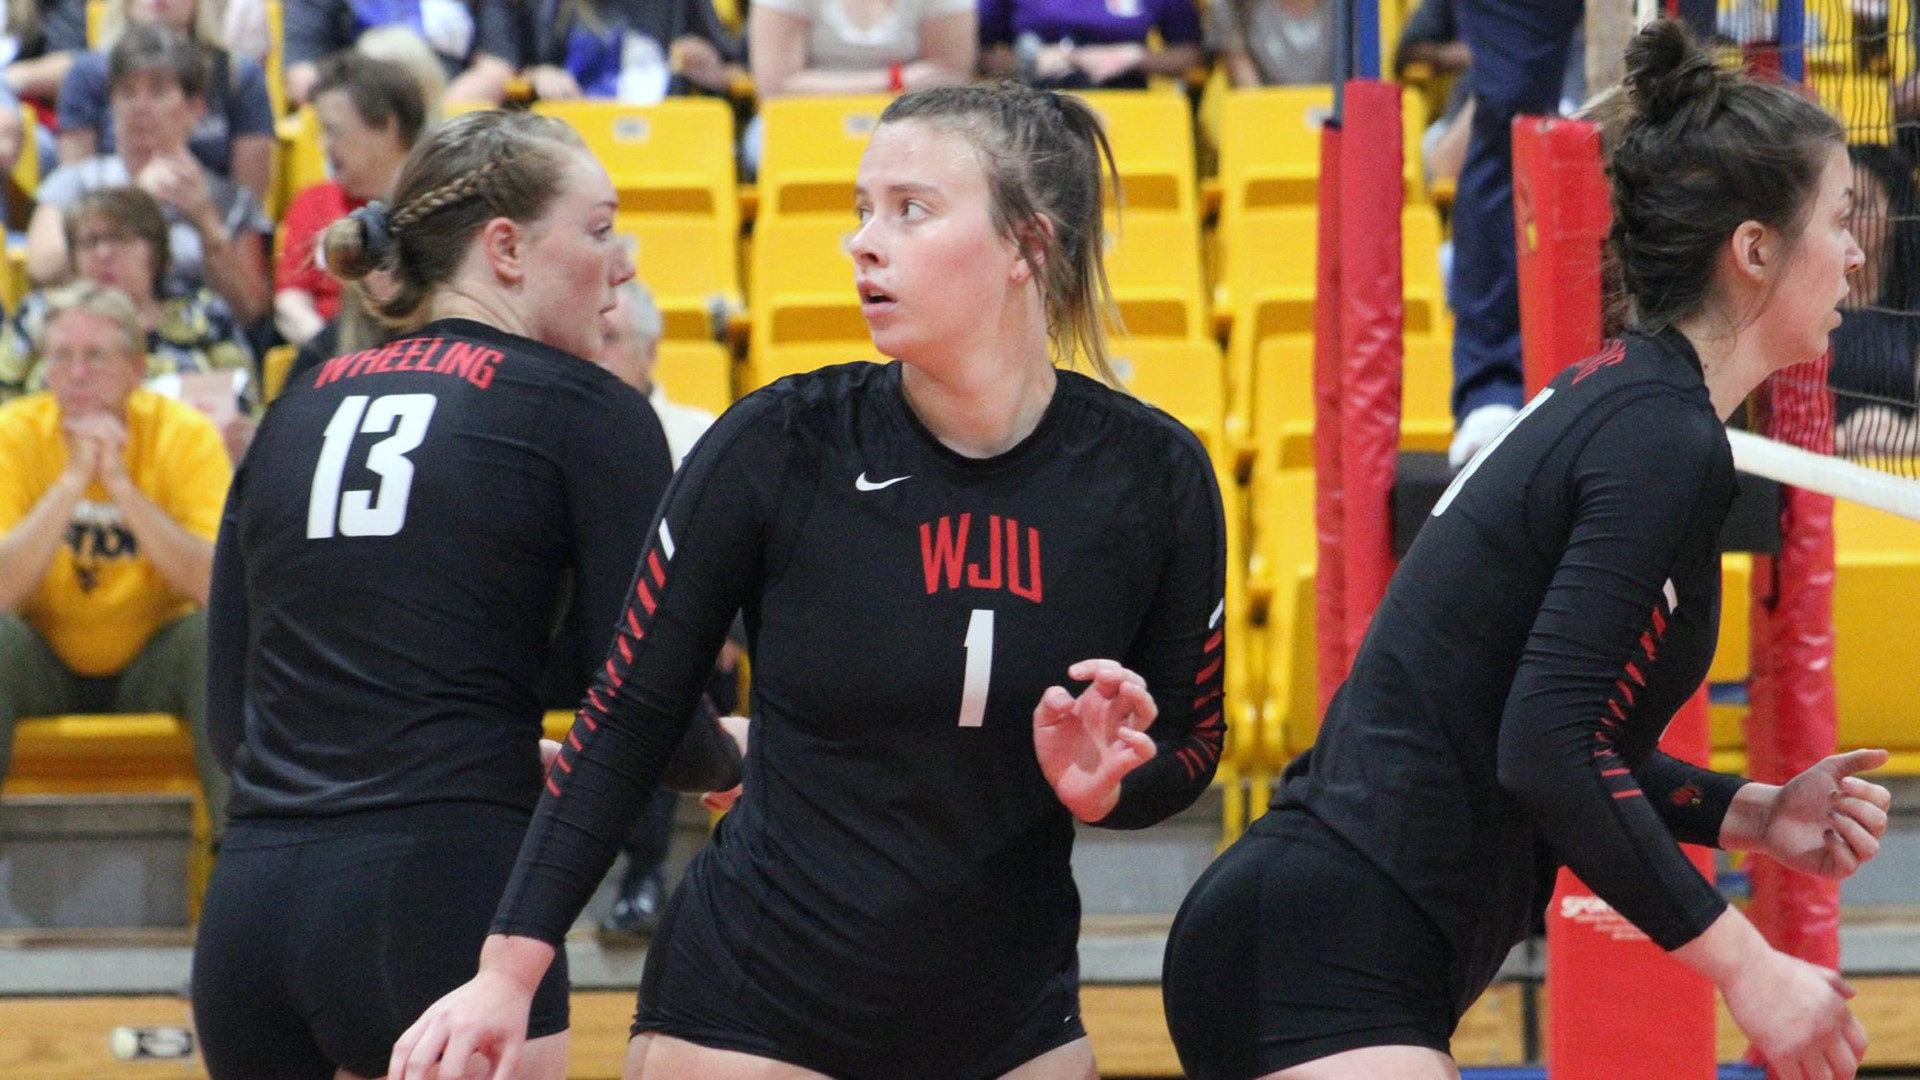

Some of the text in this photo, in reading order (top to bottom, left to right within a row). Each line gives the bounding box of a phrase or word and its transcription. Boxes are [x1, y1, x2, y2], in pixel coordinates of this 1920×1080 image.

[314, 338, 505, 389] WHEELING
[307, 394, 437, 539] 13
[919, 512, 1043, 603] WJU
[958, 609, 994, 727] 1
